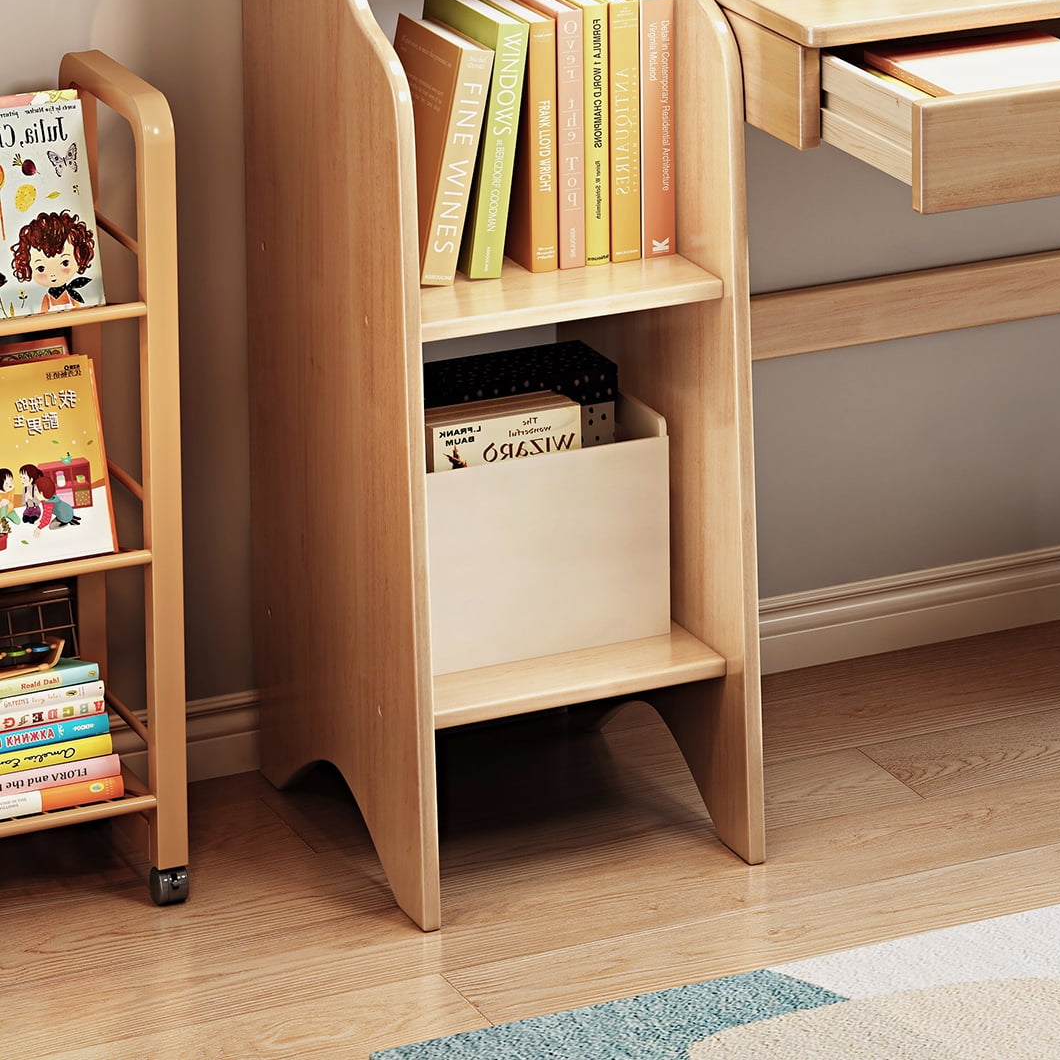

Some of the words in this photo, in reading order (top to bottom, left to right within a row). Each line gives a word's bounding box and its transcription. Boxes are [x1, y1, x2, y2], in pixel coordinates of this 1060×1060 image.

[647, 21, 657, 50] Virginia
[660, 20, 669, 42] Detail
[649, 52, 658, 81] McLeod
[661, 52, 670, 103] Contemporary
[493, 32, 523, 136] WINDOWS
[453, 82, 483, 145] FINE
[538, 100, 551, 128] FRANK
[662, 106, 670, 145] Residential
[539, 129, 551, 157] LLOYD
[492, 147, 504, 188] BERGDORF
[539, 159, 552, 192] WRIGHT
[662, 148, 670, 192] Architecture
[434, 160, 470, 252] WINES
[487, 189, 500, 232] GOODMAN
[21, 680, 41, 690] Roald
[43, 677, 60, 686] Dahl
[6, 728, 55, 747] КНИЖКА
[23, 747, 76, 763] Amelia
[6, 781, 24, 789] the
[27, 776, 49, 787] and
[52, 768, 88, 780] FLORA
